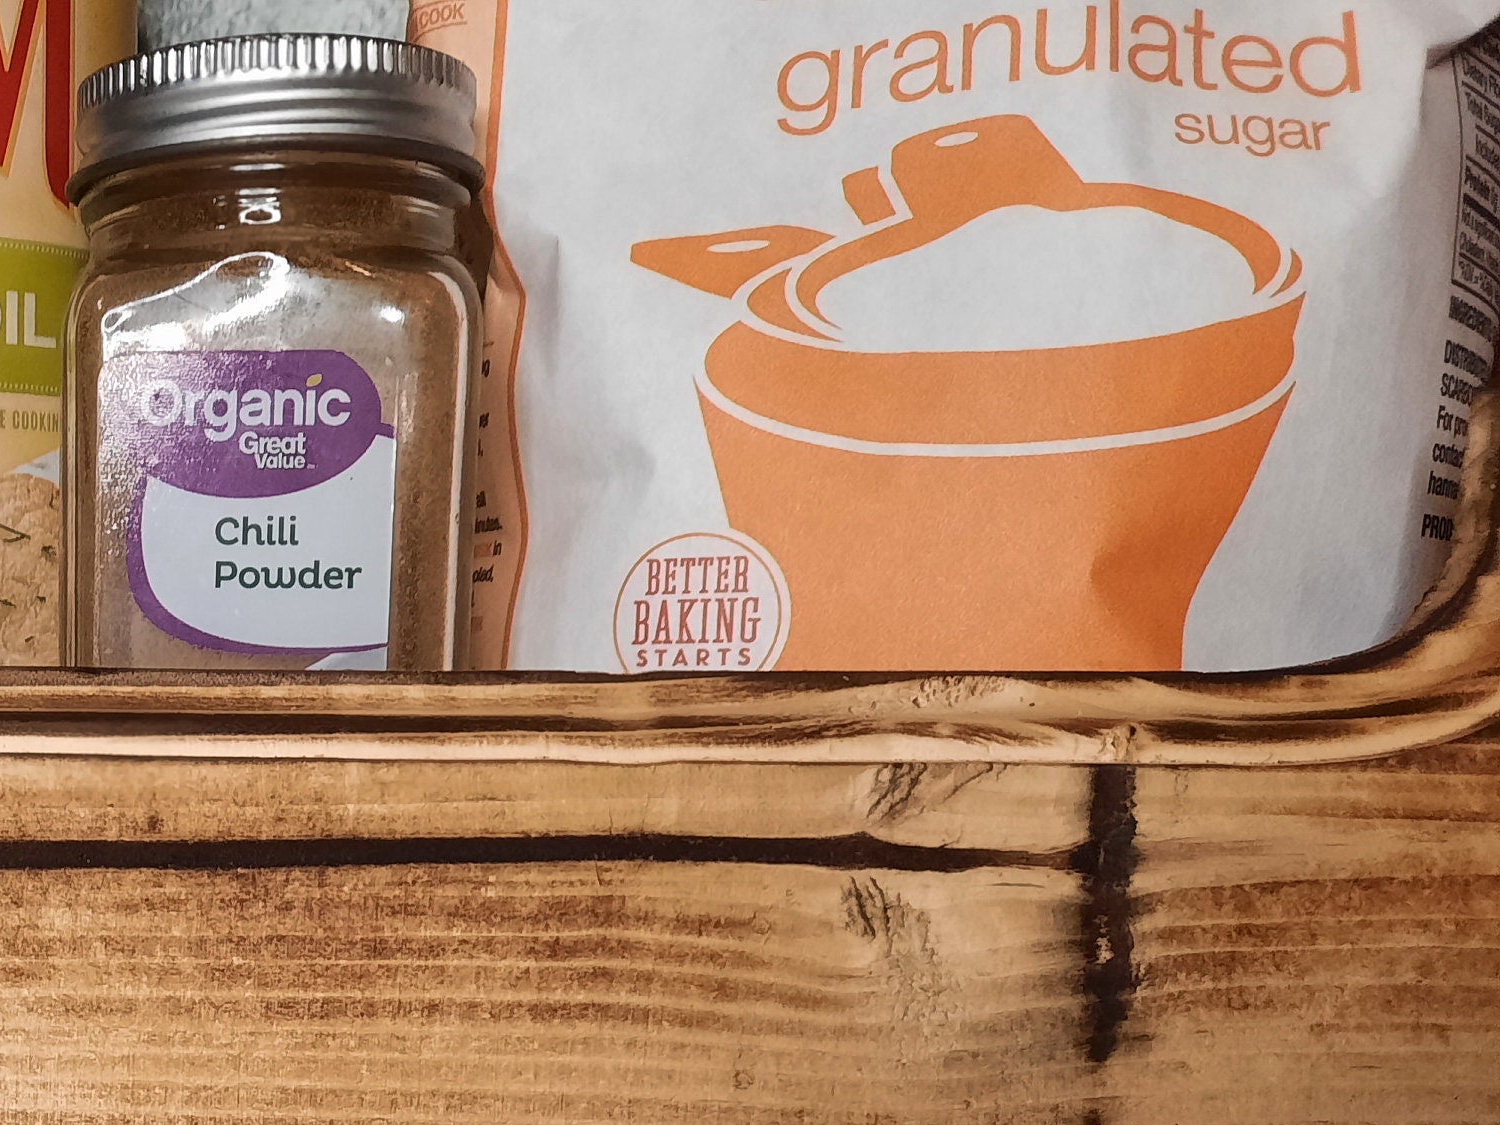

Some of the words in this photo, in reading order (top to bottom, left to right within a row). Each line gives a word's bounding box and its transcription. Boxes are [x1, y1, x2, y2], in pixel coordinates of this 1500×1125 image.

[419, 3, 465, 29] COOK
[776, 0, 1363, 136] granulated
[1173, 111, 1332, 157] sugar
[12, 410, 60, 433] COOKIN
[143, 373, 352, 442] Organic
[239, 431, 307, 455] Great
[255, 453, 306, 470] Value
[214, 515, 299, 546] Chili
[214, 560, 362, 589] Powder
[645, 555, 750, 596] BETTER
[631, 597, 761, 646] BAKING
[636, 647, 751, 667] STARTS
